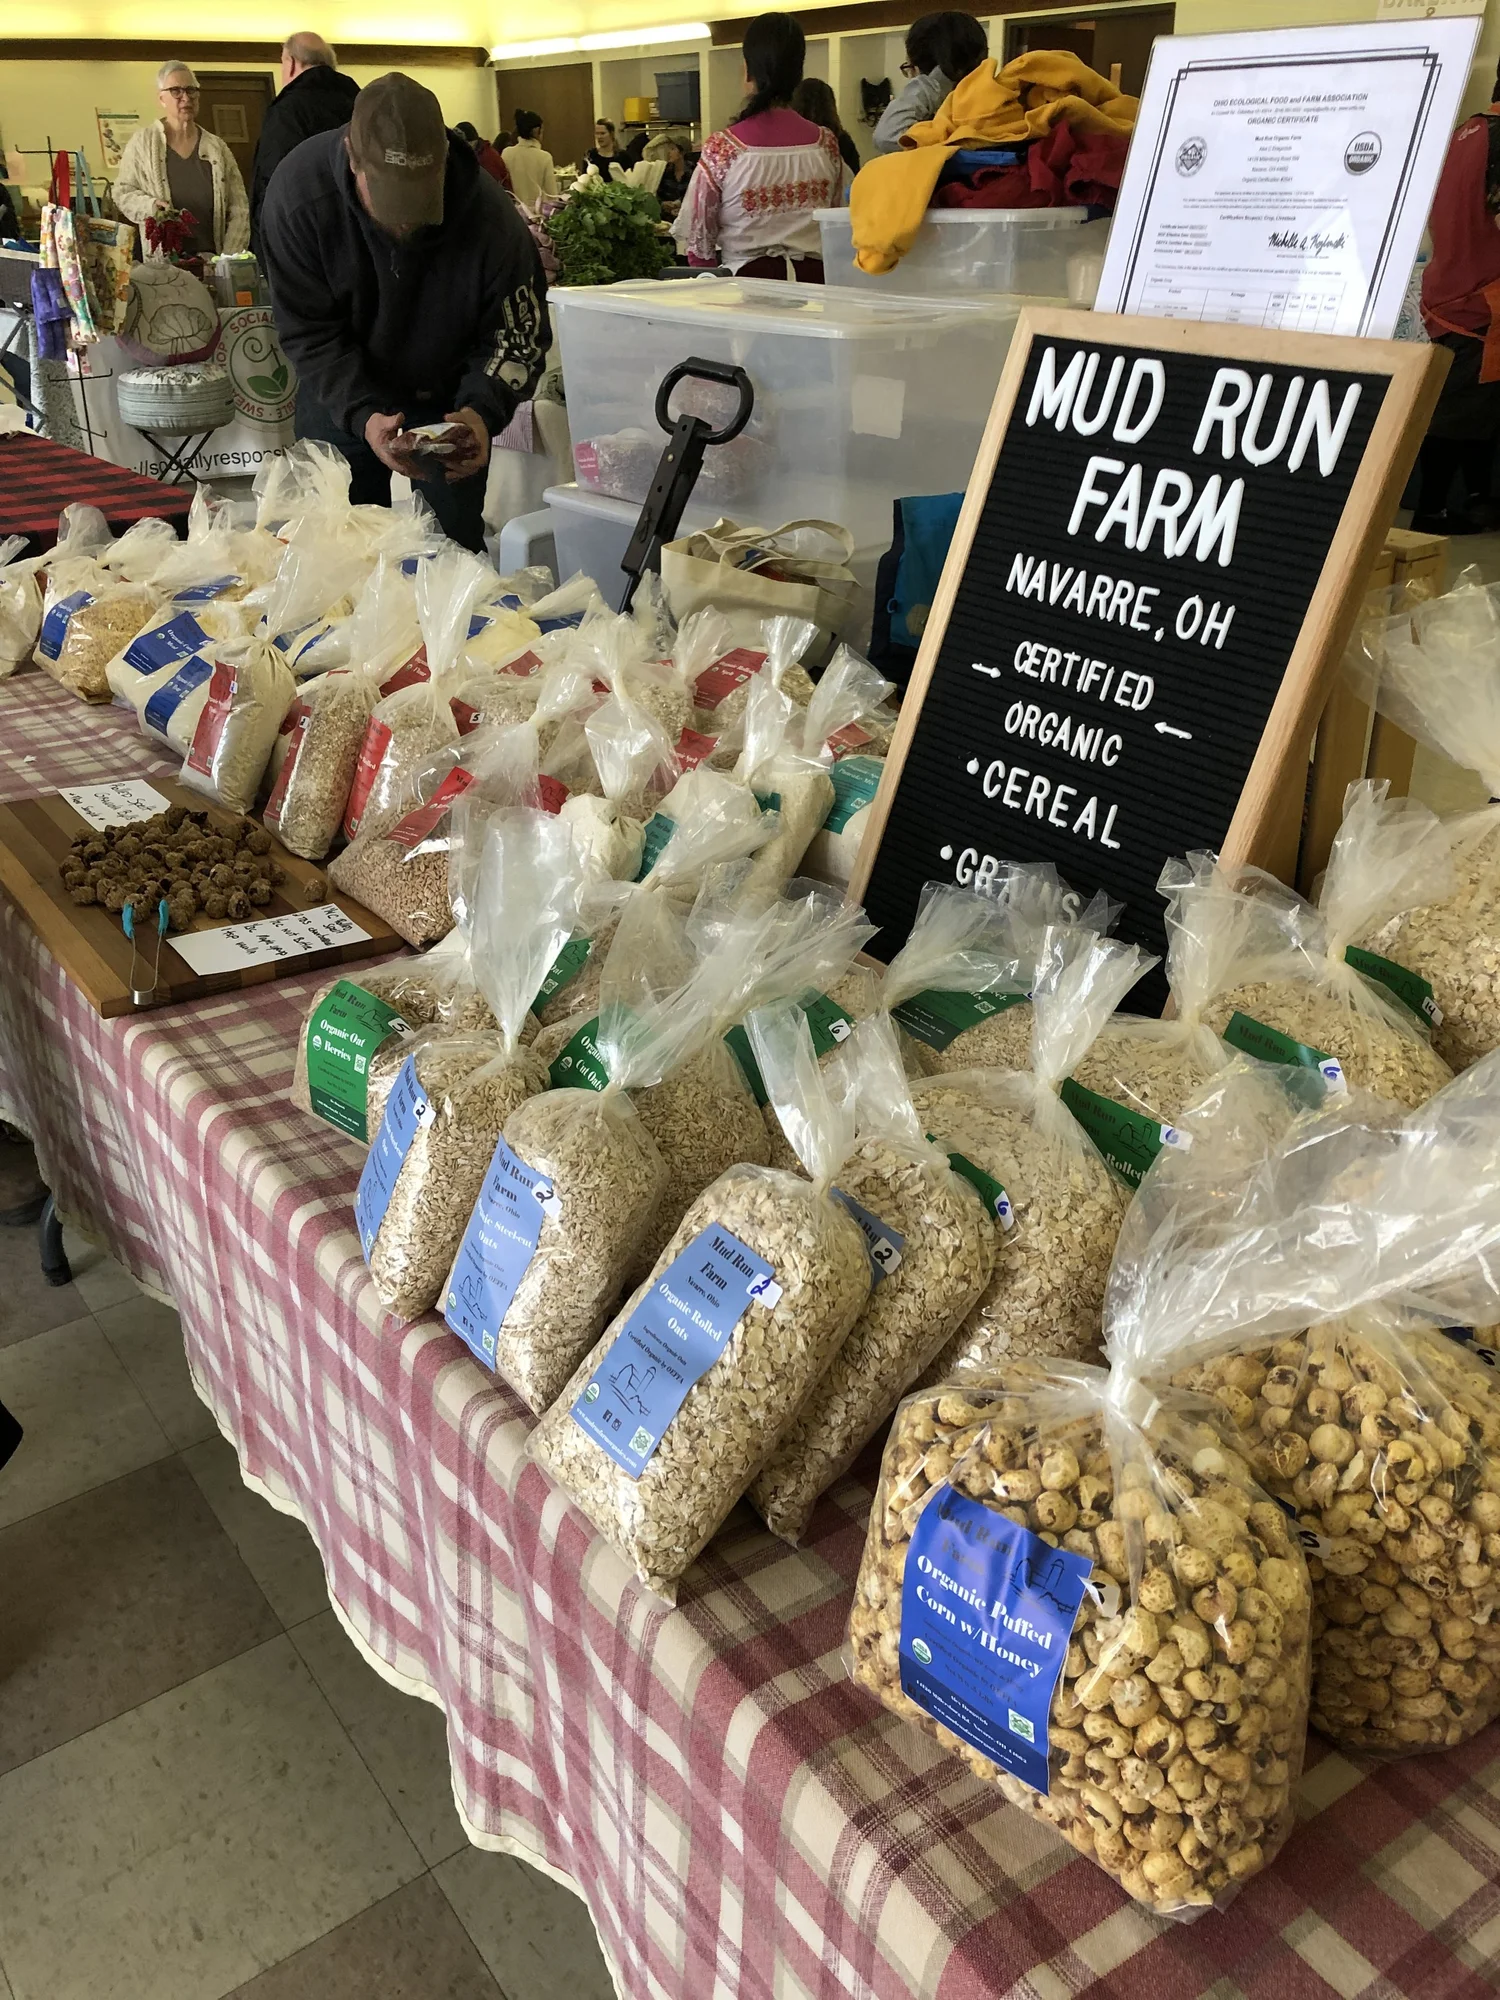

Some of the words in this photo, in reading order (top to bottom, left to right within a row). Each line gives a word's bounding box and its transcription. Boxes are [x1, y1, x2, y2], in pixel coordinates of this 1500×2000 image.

[1229, 97, 1268, 106] ECOLOGICAL
[1270, 96, 1288, 104] FOOD
[1302, 95, 1322, 103] FARM
[1322, 93, 1368, 102] ASSOCIATION
[1247, 117, 1276, 125] ORGANIC
[1277, 115, 1319, 124] CERTIFICATE
[1354, 142, 1374, 151] USDA
[1349, 155, 1374, 164] ORGANIC
[1024, 346, 1166, 445] MUD
[1191, 366, 1364, 478] RUN
[1066, 455, 1245, 568] FARM
[1004, 553, 1166, 643] NAVARRE,
[1174, 595, 1237, 650] OH
[1012, 640, 1156, 713] CERTIFIED
[472, 714, 480, 722] 5
[1003, 700, 1124, 768] ORGANIC
[982, 760, 1122, 851] CEREAL
[328, 1004, 348, 1019] Farm
[319, 1019, 350, 1041] Organic
[350, 1032, 367, 1048] Oat
[323, 1040, 352, 1062] Berries
[575, 1059, 589, 1077] Cut
[587, 1070, 604, 1092] Oats
[415, 1104, 426, 1120] 2
[1093, 1103, 1117, 1124] Run
[1165, 1128, 1179, 1145] 6
[492, 1173, 518, 1203] Farm
[509, 1165, 535, 1191] Run
[535, 1189, 554, 1204] 2
[998, 1201, 1009, 1216] 6
[505, 1203, 521, 1220] Ohio
[477, 1229, 498, 1251] Oats
[494, 1219, 533, 1249] Steel-cut
[708, 1236, 732, 1260] Mud
[732, 1252, 755, 1278] Run
[874, 1247, 893, 1264] 2
[699, 1261, 728, 1292] Farm
[750, 1278, 771, 1296] 2
[658, 1283, 692, 1315] Organic
[691, 1307, 724, 1342] Rolled
[706, 1292, 721, 1309] Ohio
[666, 1317, 689, 1342] Oats
[627, 1331, 646, 1351] Certified
[644, 1346, 662, 1366] Organic
[916, 1555, 987, 1611] Organic
[990, 1600, 1053, 1651] Puffed
[916, 1585, 957, 1627] Corn
[960, 1620, 1044, 1679] w/Honey
